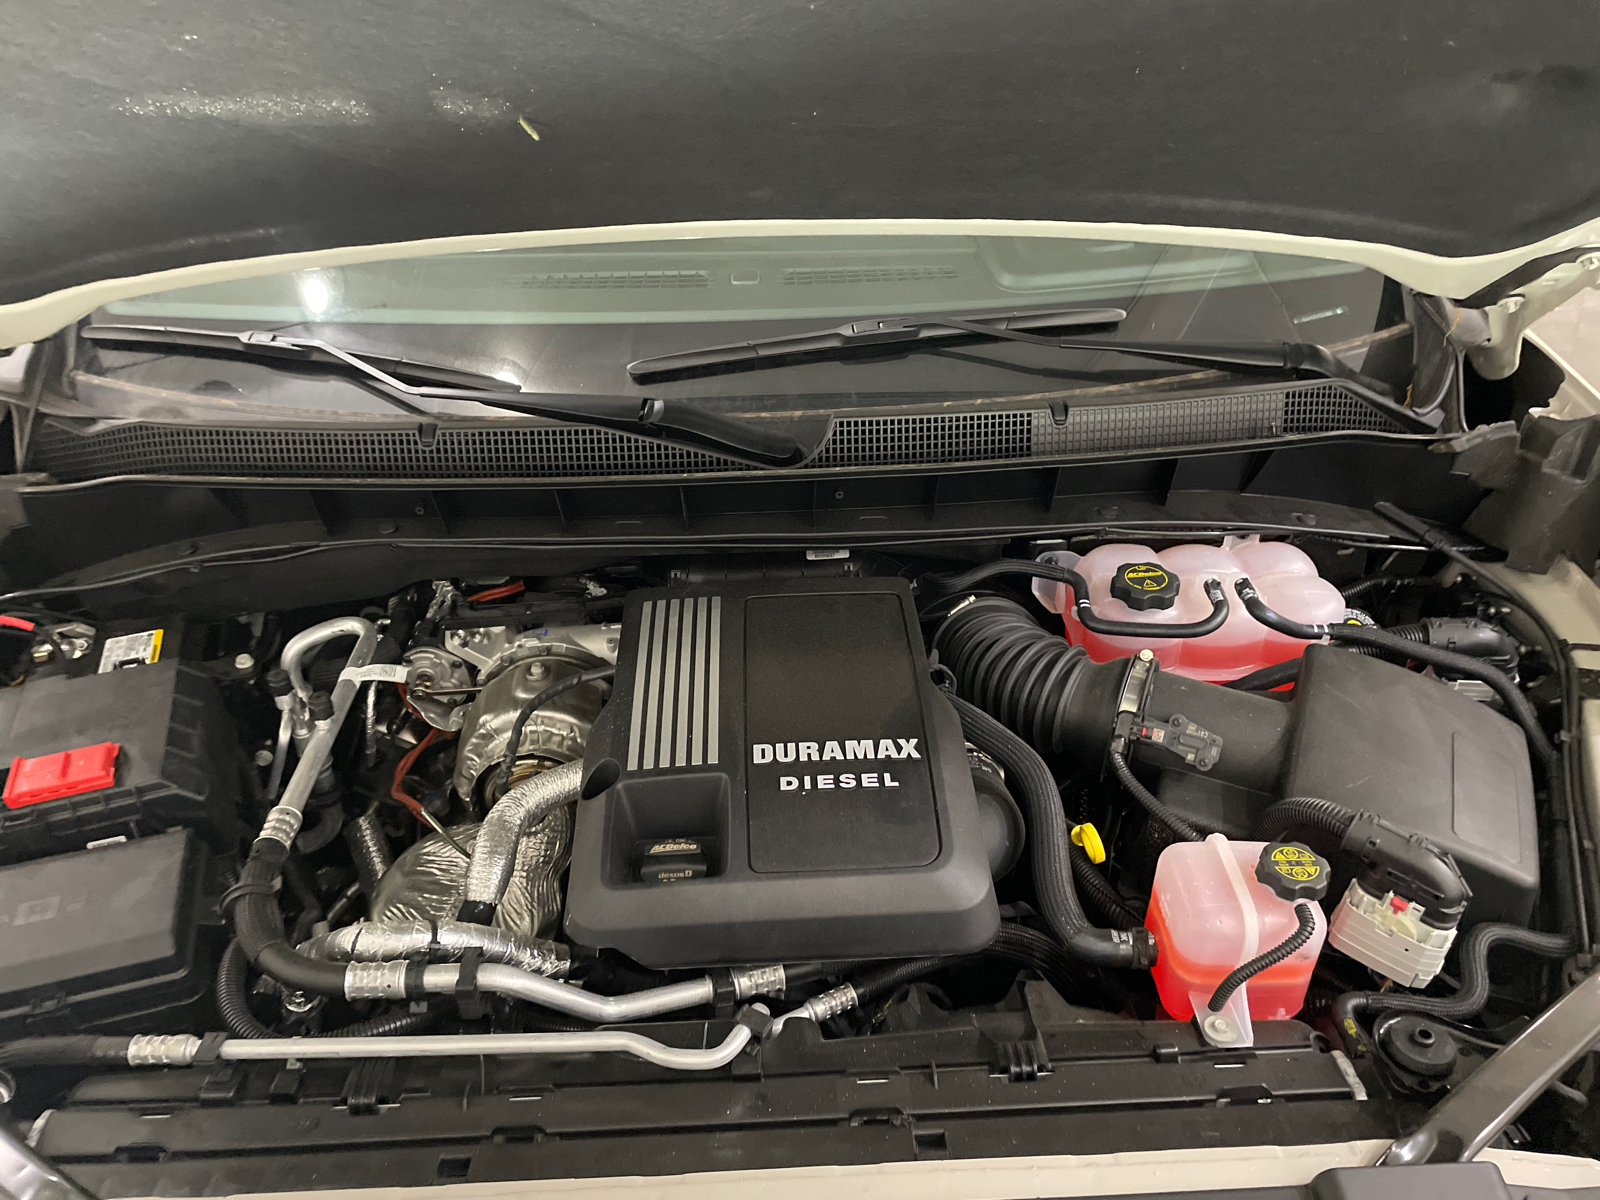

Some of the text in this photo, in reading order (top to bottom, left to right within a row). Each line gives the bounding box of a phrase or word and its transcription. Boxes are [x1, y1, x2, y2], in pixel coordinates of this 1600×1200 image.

[752, 738, 922, 764] DURAMAX
[779, 772, 900, 791] DIESEL
[649, 842, 698, 854] ACDelco
